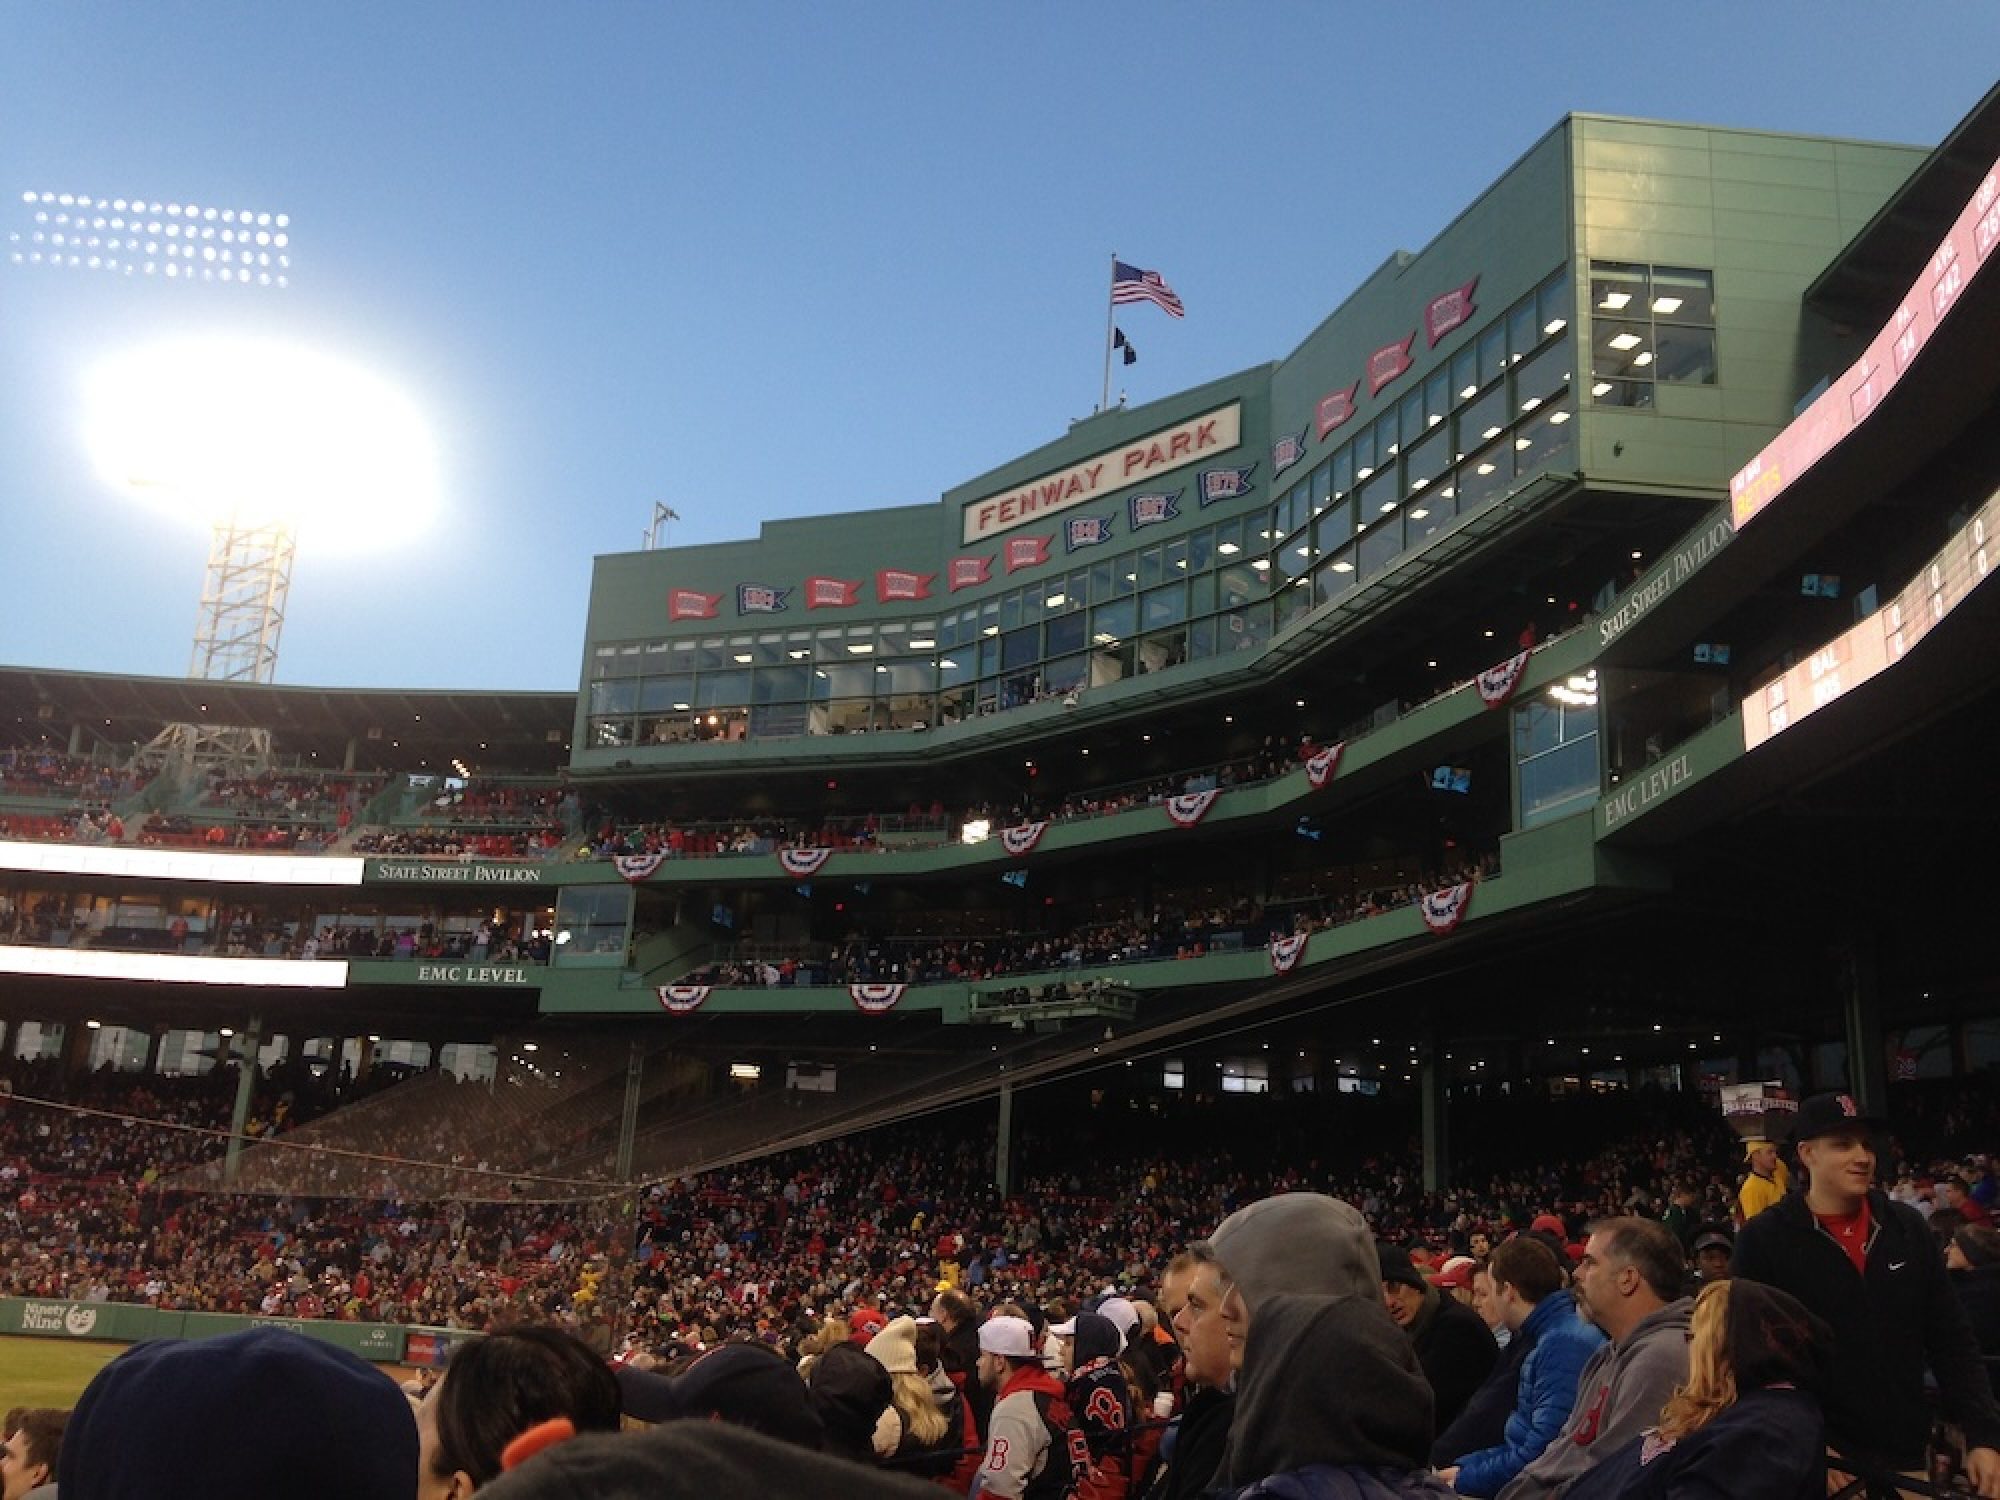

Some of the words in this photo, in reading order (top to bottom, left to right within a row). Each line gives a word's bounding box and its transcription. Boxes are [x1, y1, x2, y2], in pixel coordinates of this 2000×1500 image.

[977, 463, 1103, 531] FENWAY
[1123, 419, 1217, 477] PARK
[1975, 517, 1984, 545] 0
[1978, 549, 1987, 575] 0
[1932, 563, 1940, 588] 0
[1600, 604, 1631, 647] STATE
[1631, 567, 1671, 619] STREET
[1934, 593, 1943, 617] 0
[1605, 785, 1637, 827] EMC
[1640, 754, 1693, 805] LEVEL
[378, 864, 418, 879] STATE
[421, 864, 471, 880] STREET
[475, 865, 541, 881] PAVILION
[418, 967, 461, 981] EMC
[466, 967, 528, 983] LEVEL
[22, 1314, 62, 1330] Nine
[24, 1302, 66, 1317] Ninety
[989, 1437, 1010, 1471] B
